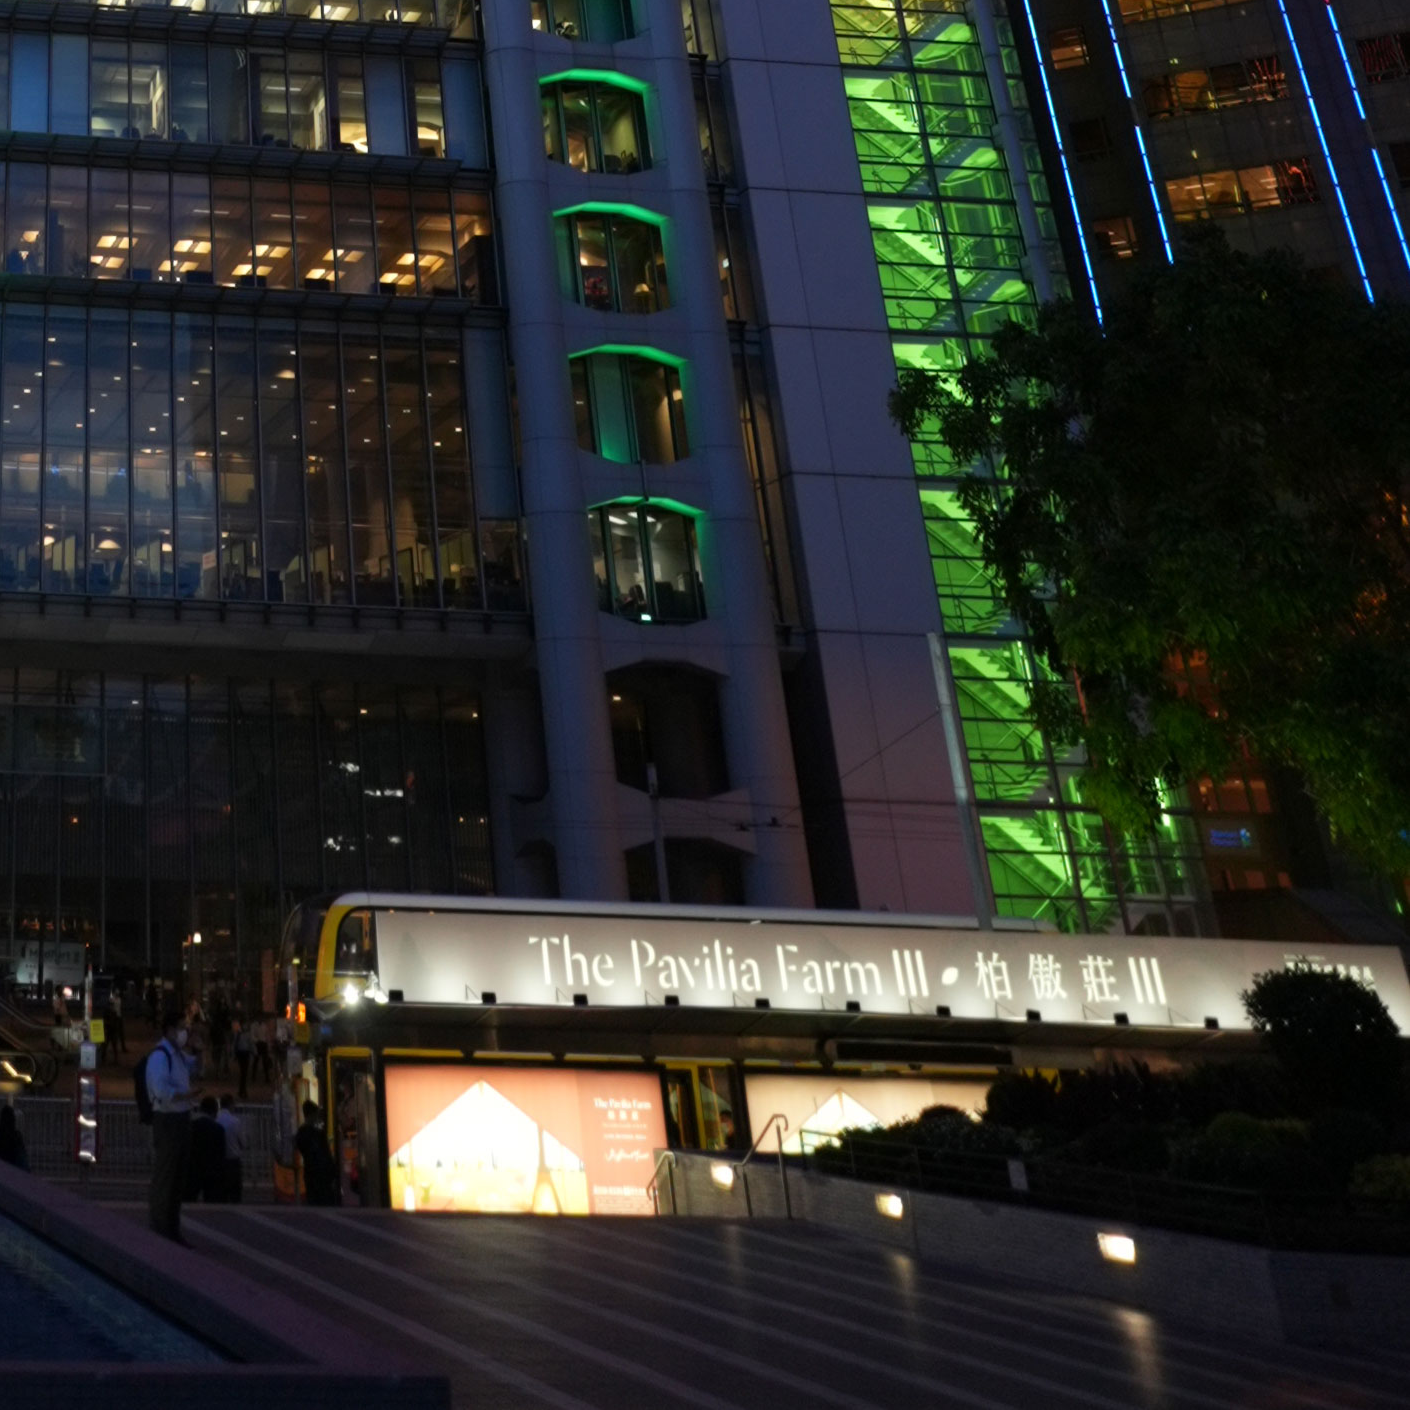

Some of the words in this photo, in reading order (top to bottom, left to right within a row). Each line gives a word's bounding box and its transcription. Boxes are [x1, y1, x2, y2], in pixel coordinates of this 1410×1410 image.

[528, 934, 614, 987] The
[630, 938, 762, 993] Pavilia
[777, 944, 884, 995] Farm
